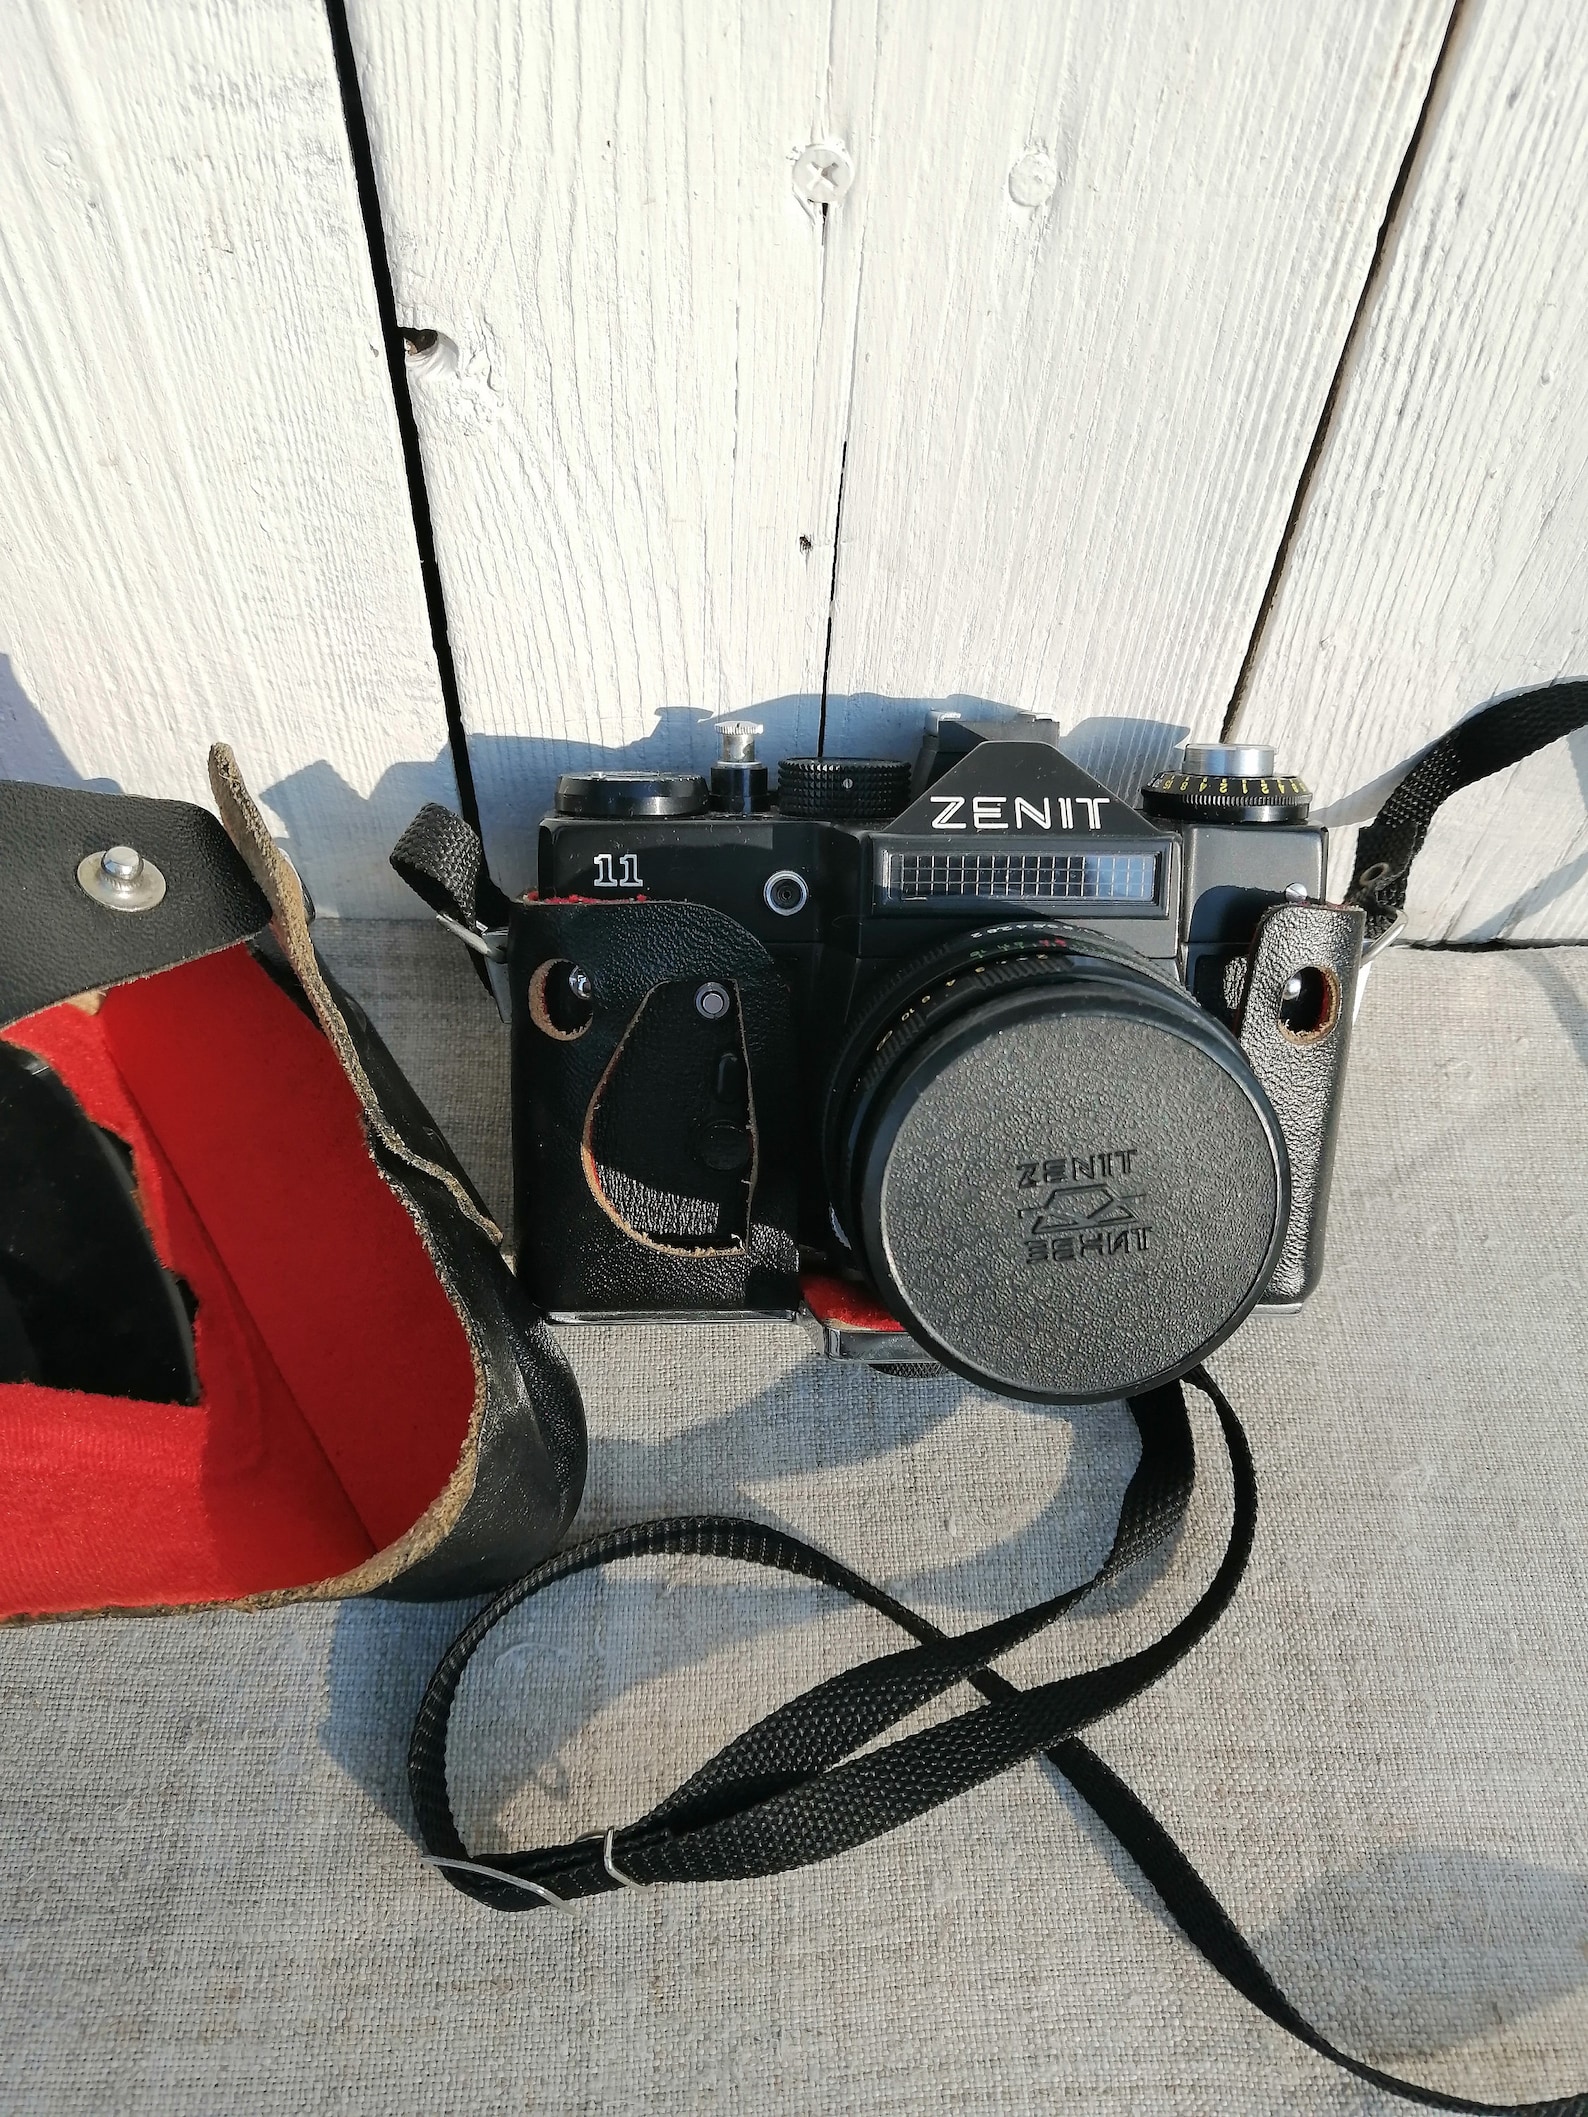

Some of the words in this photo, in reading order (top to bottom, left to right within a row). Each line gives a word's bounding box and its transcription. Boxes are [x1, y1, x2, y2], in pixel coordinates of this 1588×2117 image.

[1180, 781, 1188, 791] 8
[1199, 782, 1207, 792] 4
[1219, 782, 1228, 793] 2
[1261, 783, 1269, 794] 2
[930, 796, 1110, 829] ZENIT
[593, 853, 644, 887] 11
[1016, 1149, 1138, 1188] ZENIT
[1024, 1226, 1152, 1264] ЗЕНИТ
